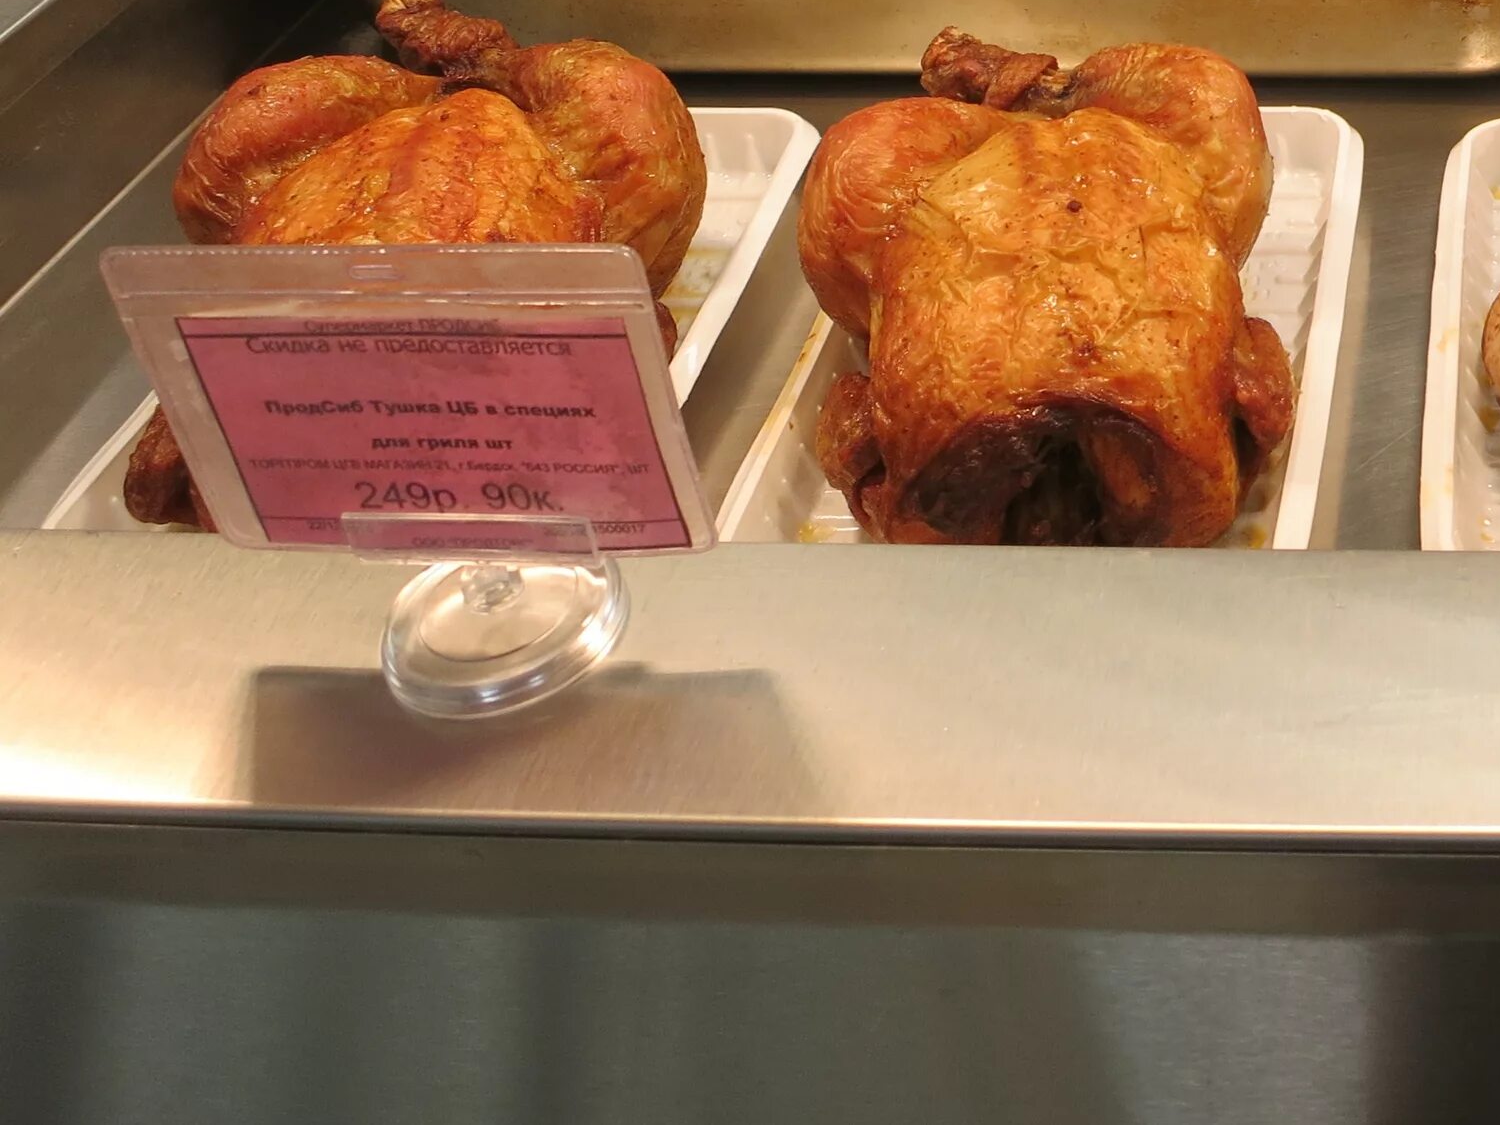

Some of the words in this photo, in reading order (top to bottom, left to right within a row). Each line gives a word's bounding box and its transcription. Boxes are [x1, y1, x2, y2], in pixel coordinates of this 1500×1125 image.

[246, 337, 330, 354] Скидка
[339, 339, 367, 353] не
[376, 338, 572, 357] предоставляется
[264, 400, 364, 417] ПродСиб
[370, 400, 441, 417] Тушка
[446, 401, 479, 417] ЦБ
[486, 405, 498, 416] в
[504, 405, 596, 419] специях
[372, 437, 410, 450] для
[417, 439, 479, 451] гриля
[485, 440, 513, 450] шт
[354, 481, 470, 513] 249р.
[481, 482, 564, 512] 90к.
